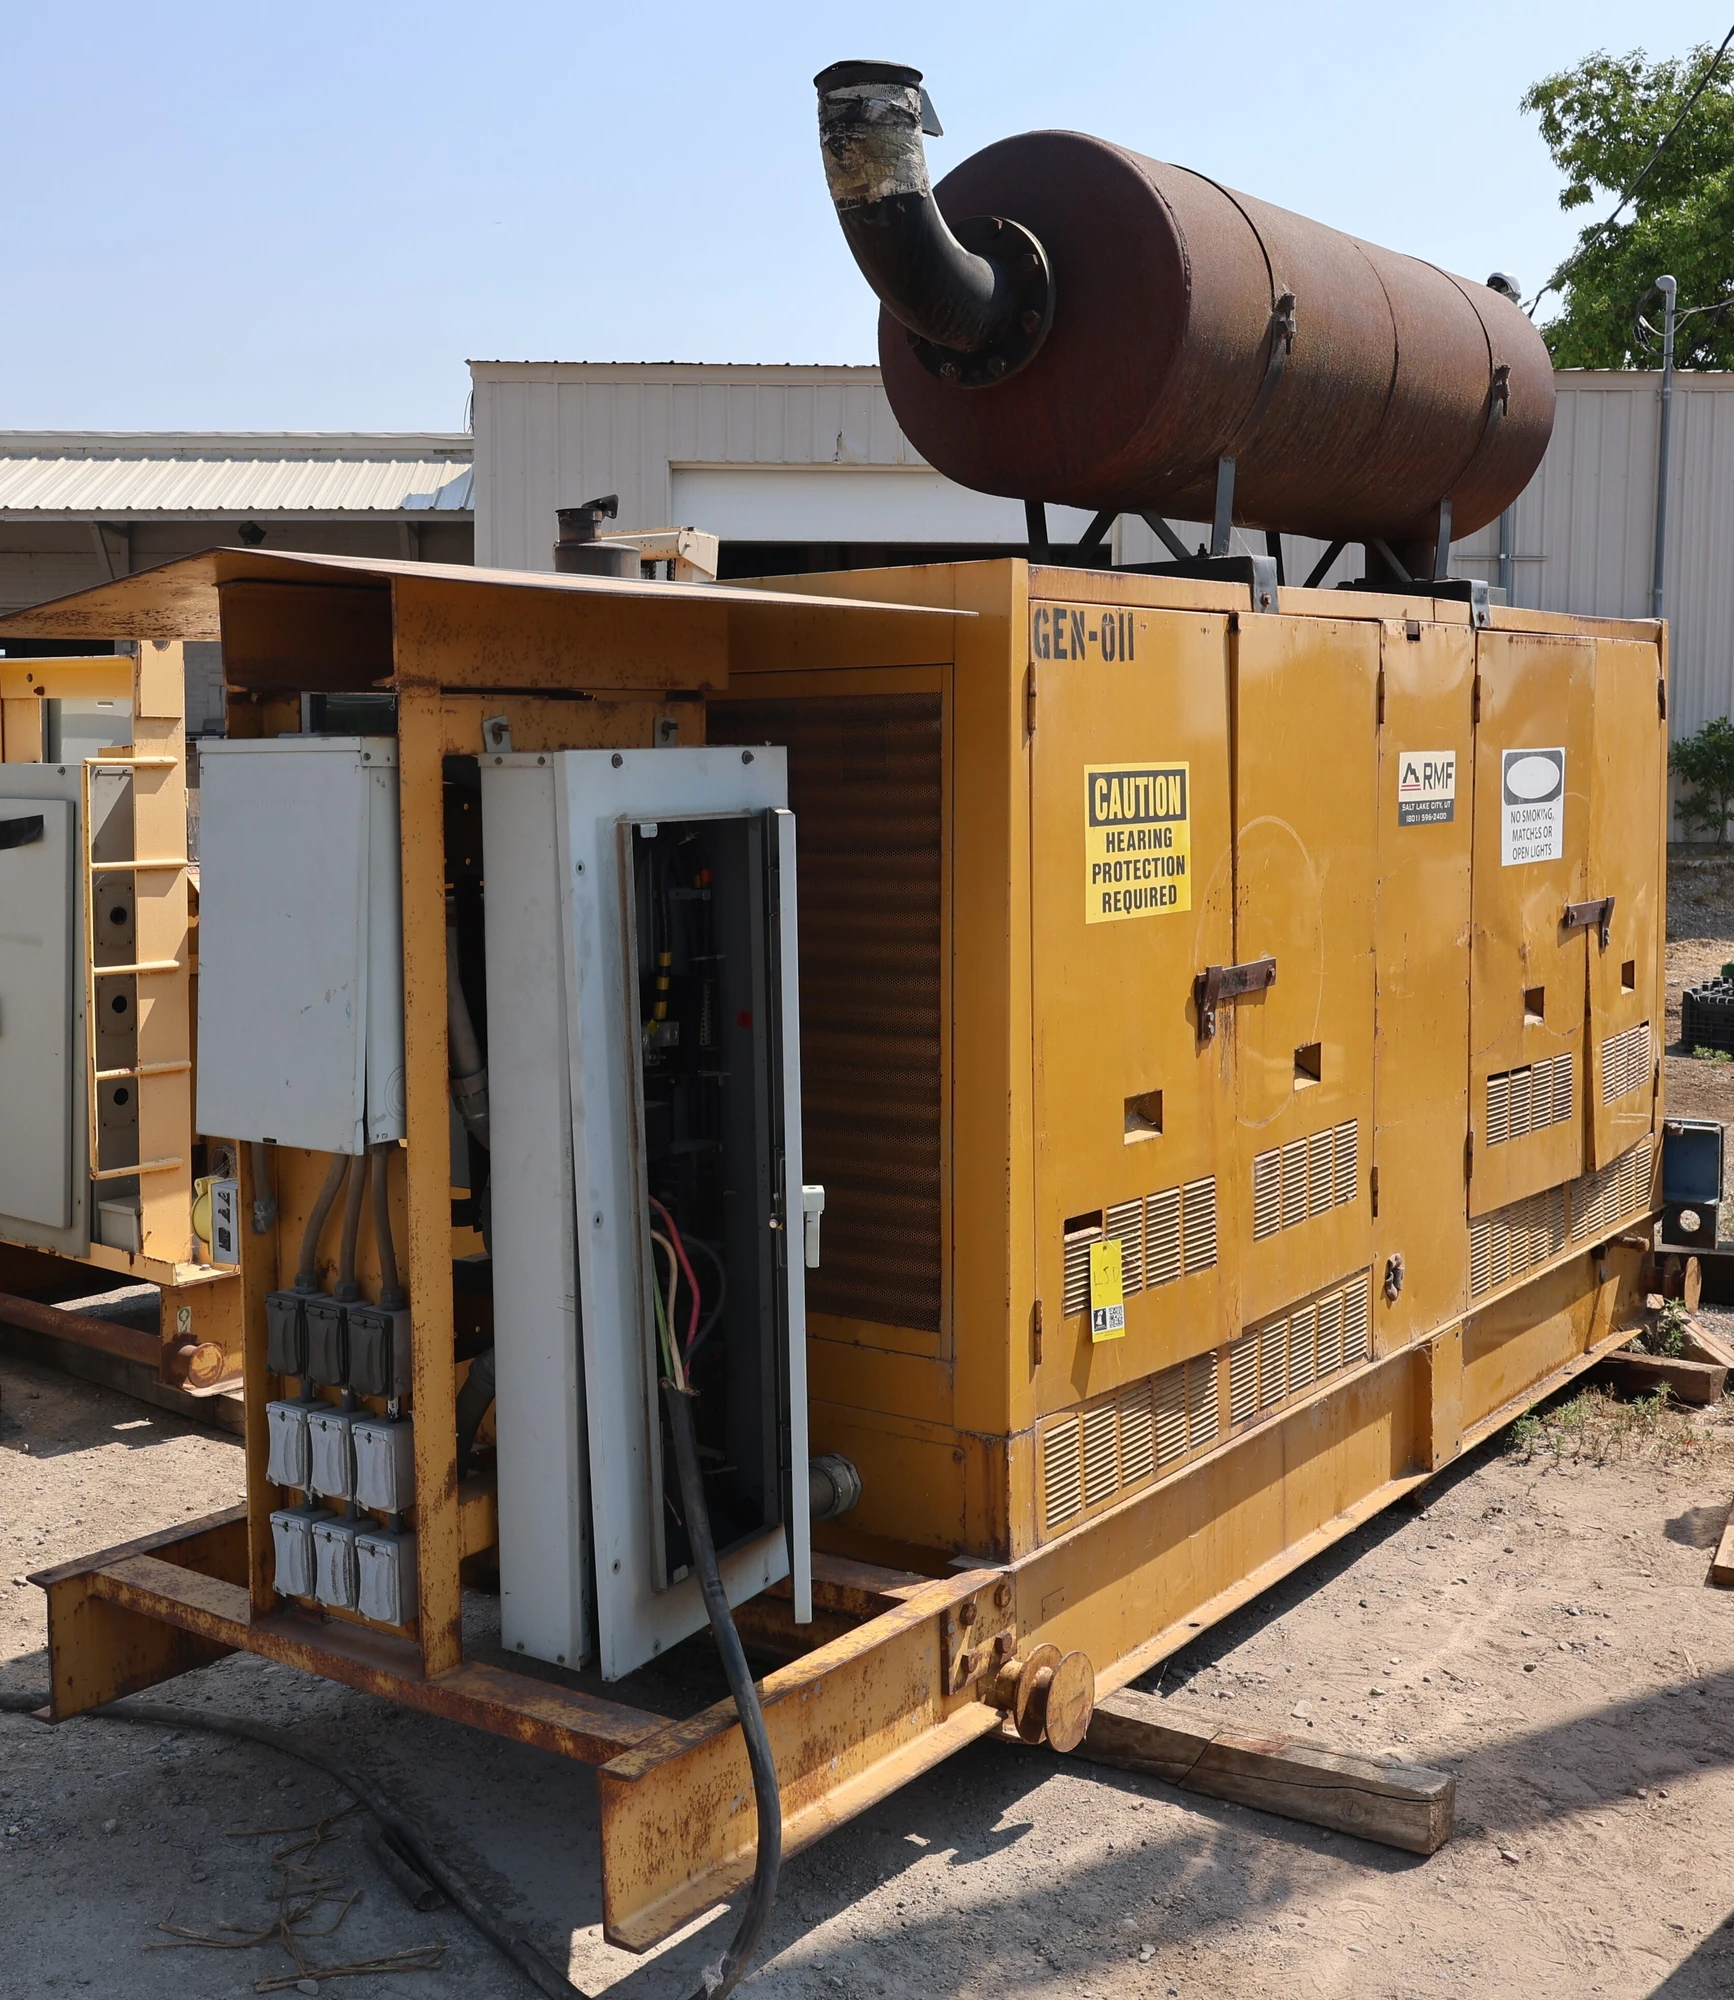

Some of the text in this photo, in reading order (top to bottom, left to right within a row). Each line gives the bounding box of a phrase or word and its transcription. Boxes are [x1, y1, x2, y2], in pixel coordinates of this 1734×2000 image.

[1033, 607, 1135, 662] GEN-011
[1423, 761, 1454, 790] RMF
[1094, 775, 1181, 821] CAUTION
[1402, 803, 1415, 811] SALT
[1416, 802, 1430, 810] LAKE
[1444, 800, 1451, 808] UT
[1406, 812, 1447, 822] (801) 596-2400
[1510, 810, 1521, 824] NO
[1105, 827, 1173, 853] HEARING
[1512, 825, 1553, 842] MATCHES OR
[1512, 843, 1552, 860] OPEN LIGHTS
[1092, 854, 1186, 885] PROTECTION
[1102, 884, 1178, 914] REQUIRED
